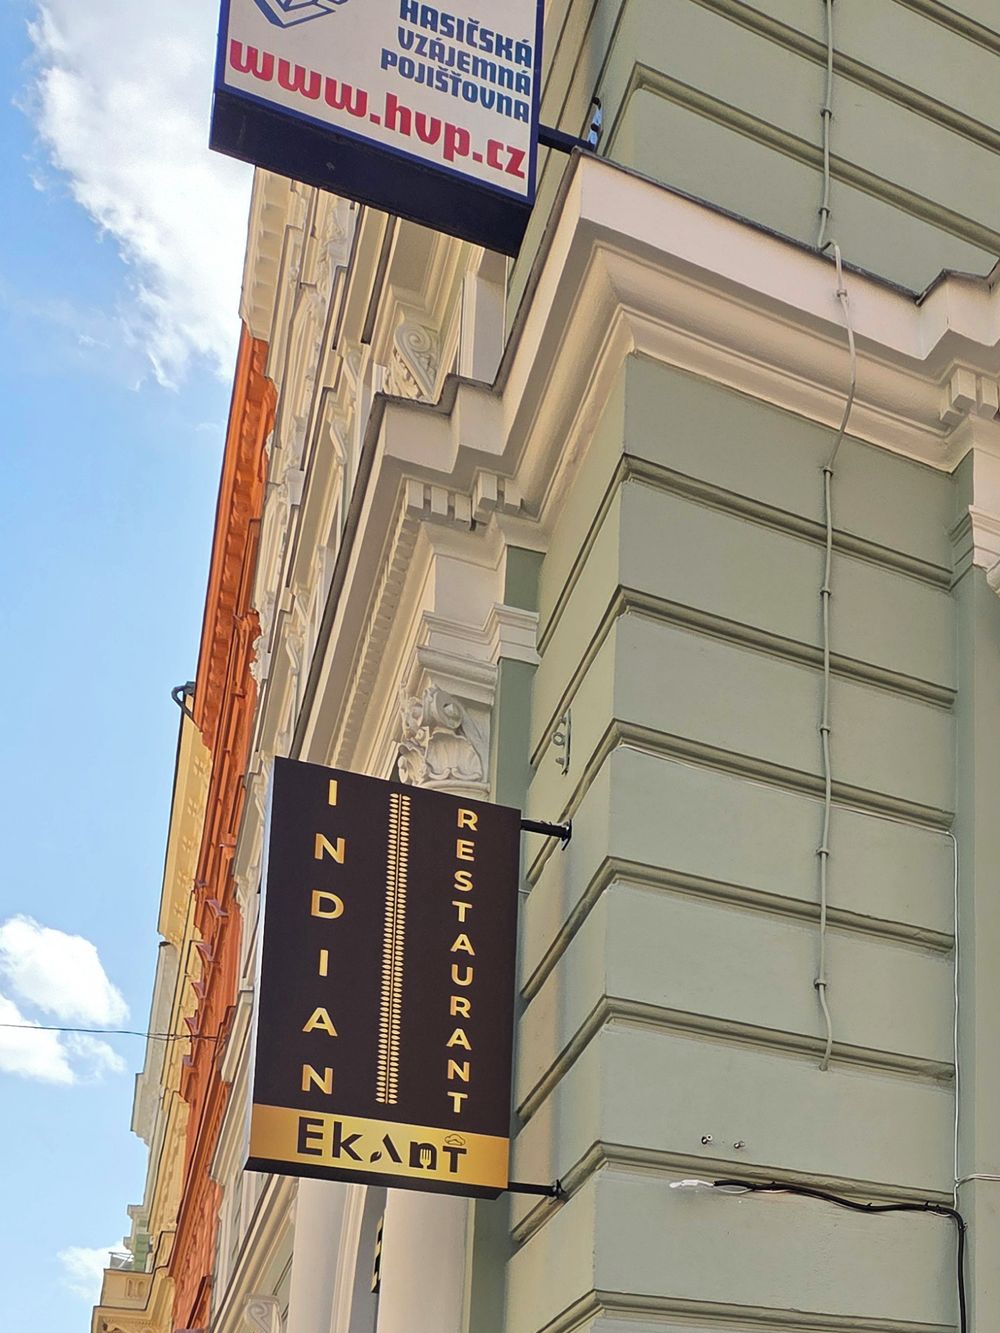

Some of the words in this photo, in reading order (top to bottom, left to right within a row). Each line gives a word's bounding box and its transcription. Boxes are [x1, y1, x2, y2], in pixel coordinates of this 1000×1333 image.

[381, 48, 529, 124] POJIŠŤOVNA
[398, 26, 531, 97] VZÁJEMNÁ
[400, 0, 532, 69] HASIČSKÁ
[230, 38, 526, 179] www.hvp.cz
[301, 779, 345, 1095] INDIAN
[446, 808, 479, 1114] RESTAURANT
